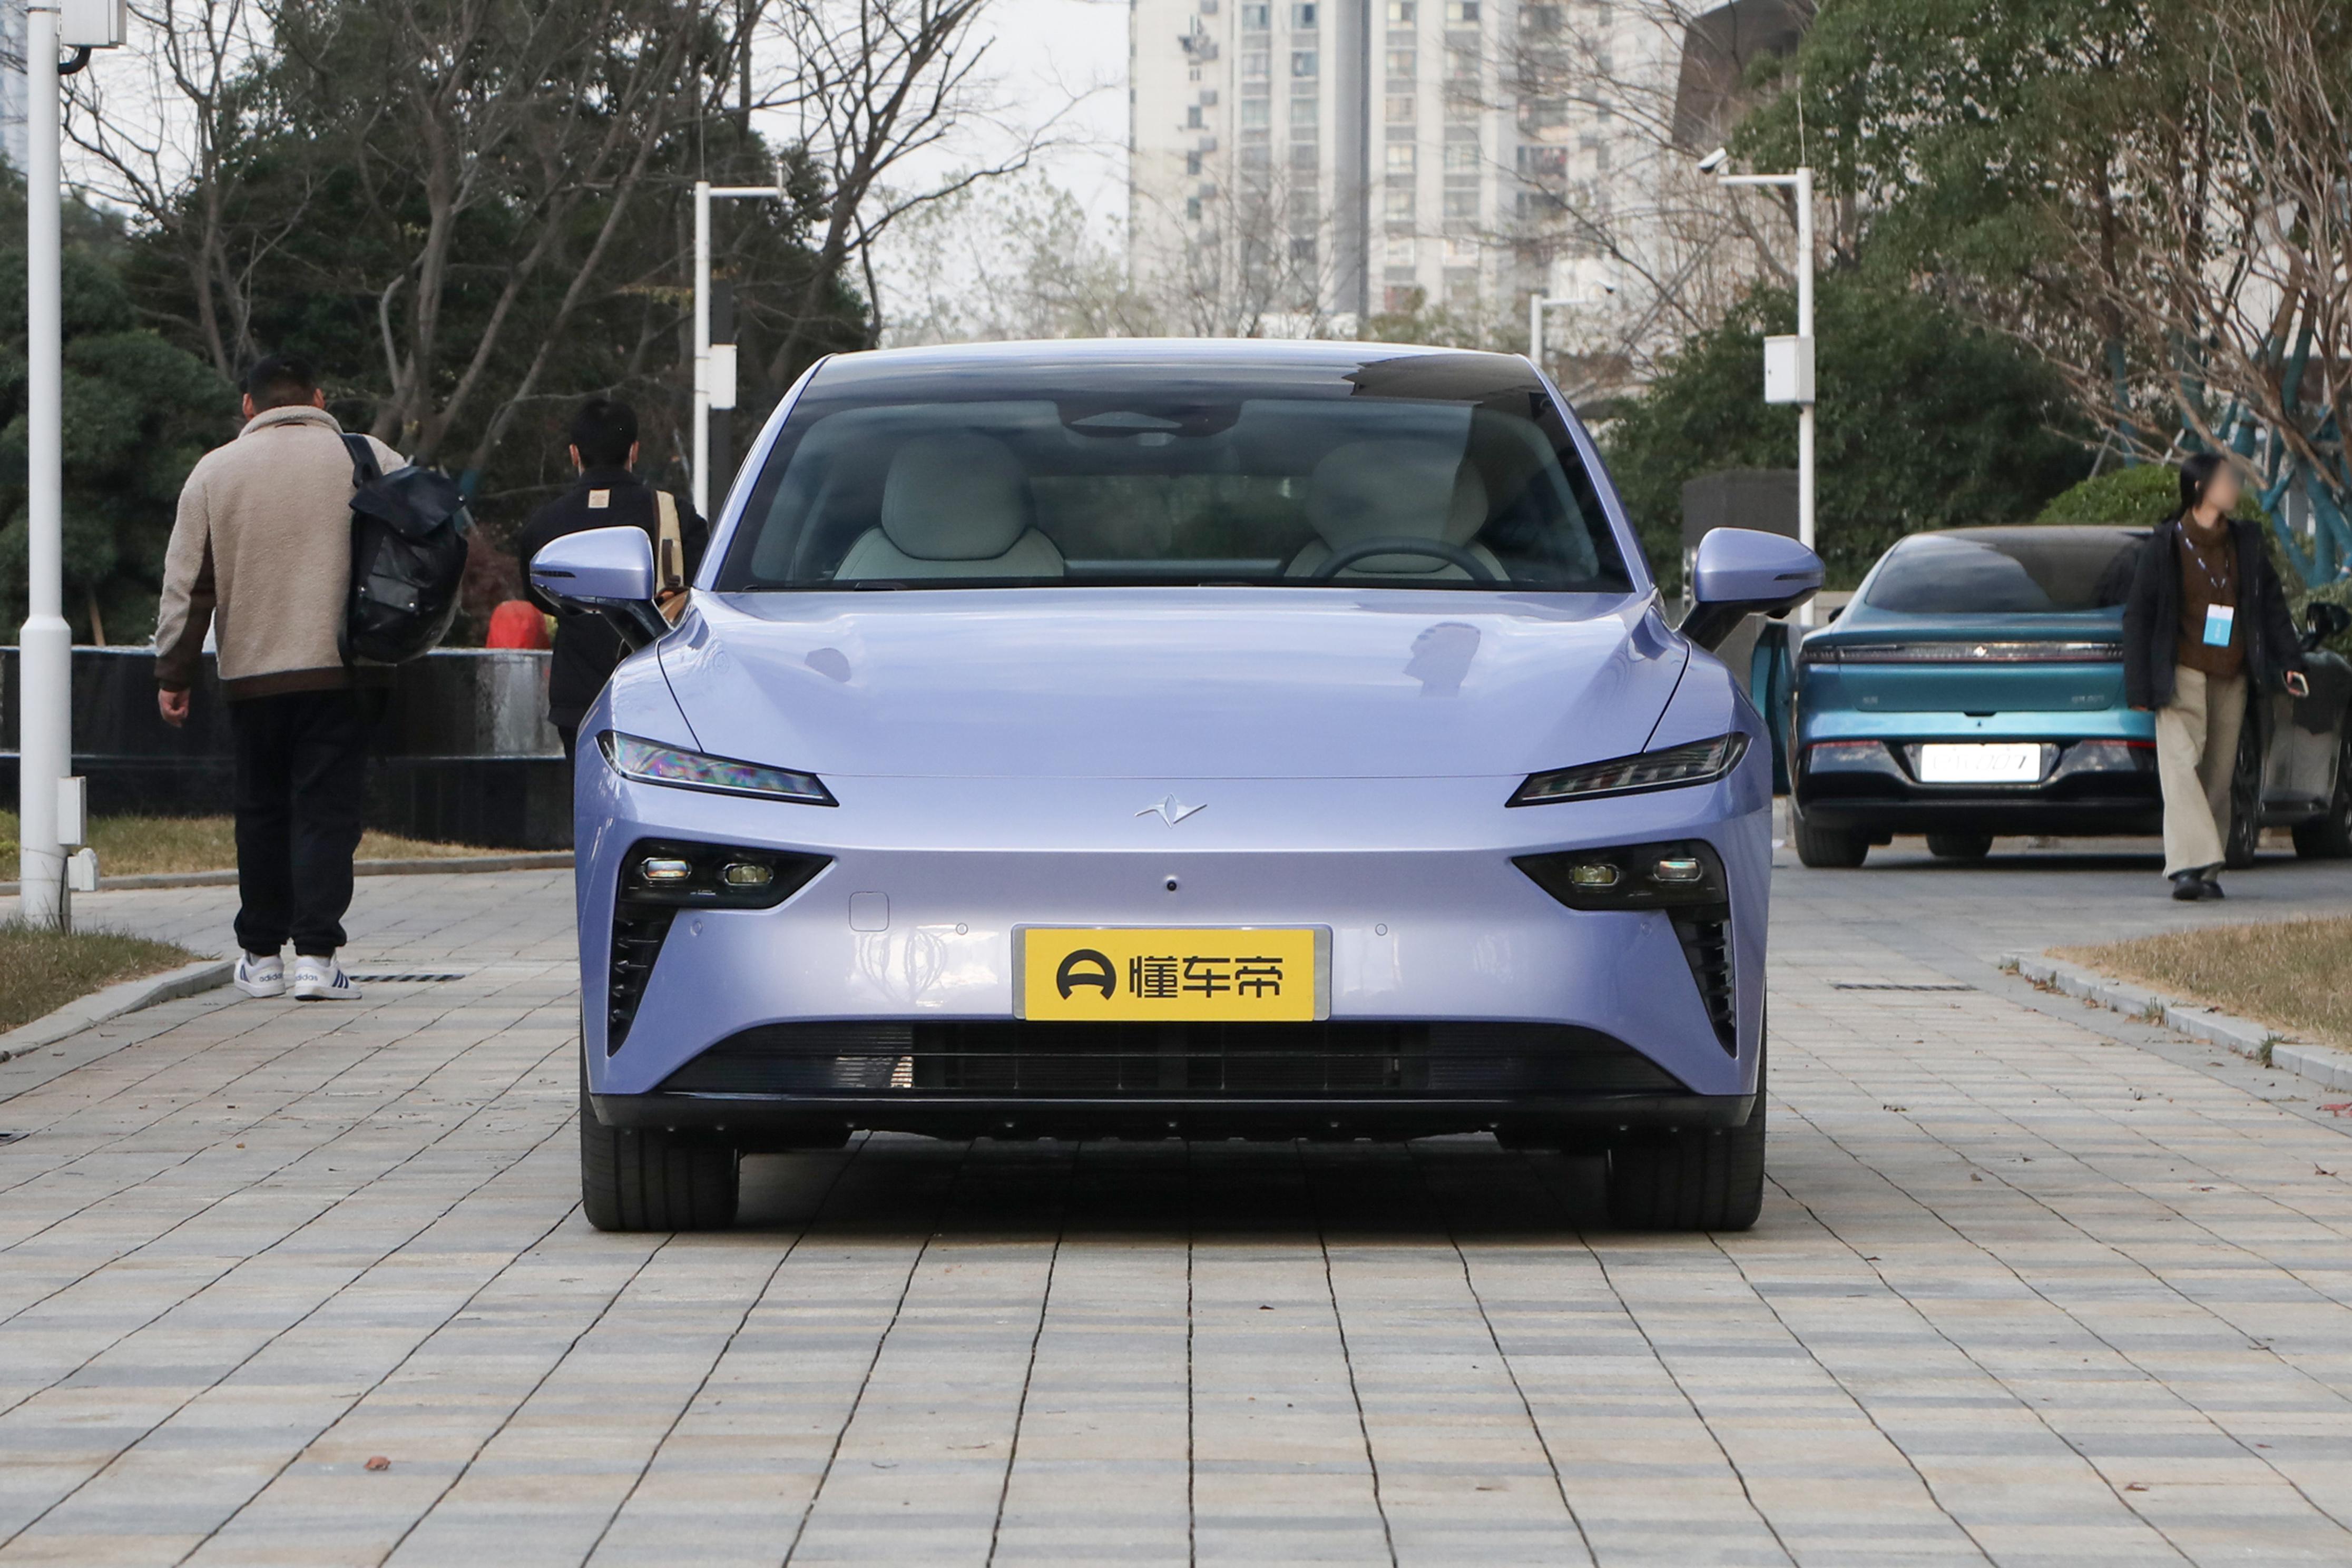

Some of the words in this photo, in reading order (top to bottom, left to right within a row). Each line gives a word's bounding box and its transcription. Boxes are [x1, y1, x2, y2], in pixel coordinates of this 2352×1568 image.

[259, 973, 283, 982] adida
[295, 973, 318, 981] didas
[1129, 955, 1283, 998] 懂车帝
